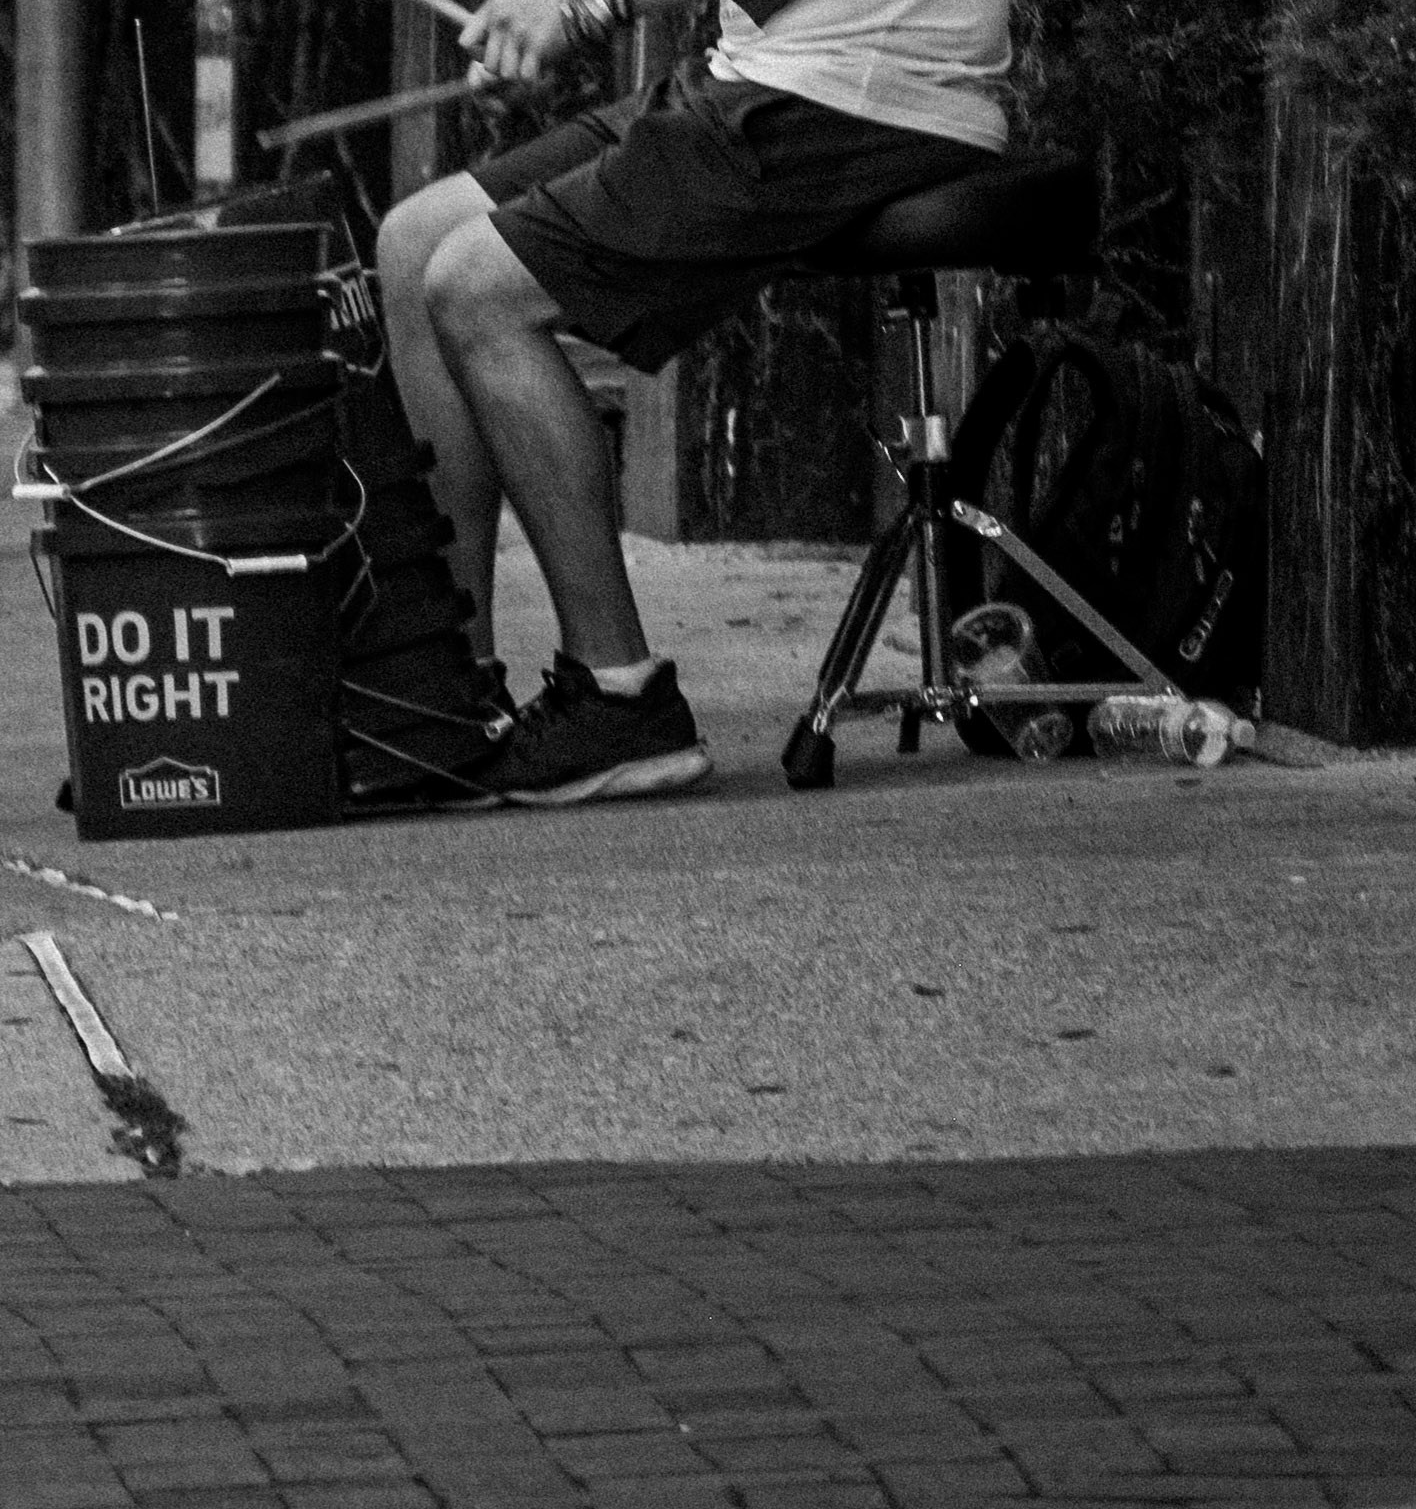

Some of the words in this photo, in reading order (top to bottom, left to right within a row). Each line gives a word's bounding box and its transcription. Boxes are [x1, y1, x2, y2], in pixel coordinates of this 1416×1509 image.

[77, 610, 150, 666] DO
[173, 606, 234, 662] IT
[82, 670, 240, 723] RIGHT
